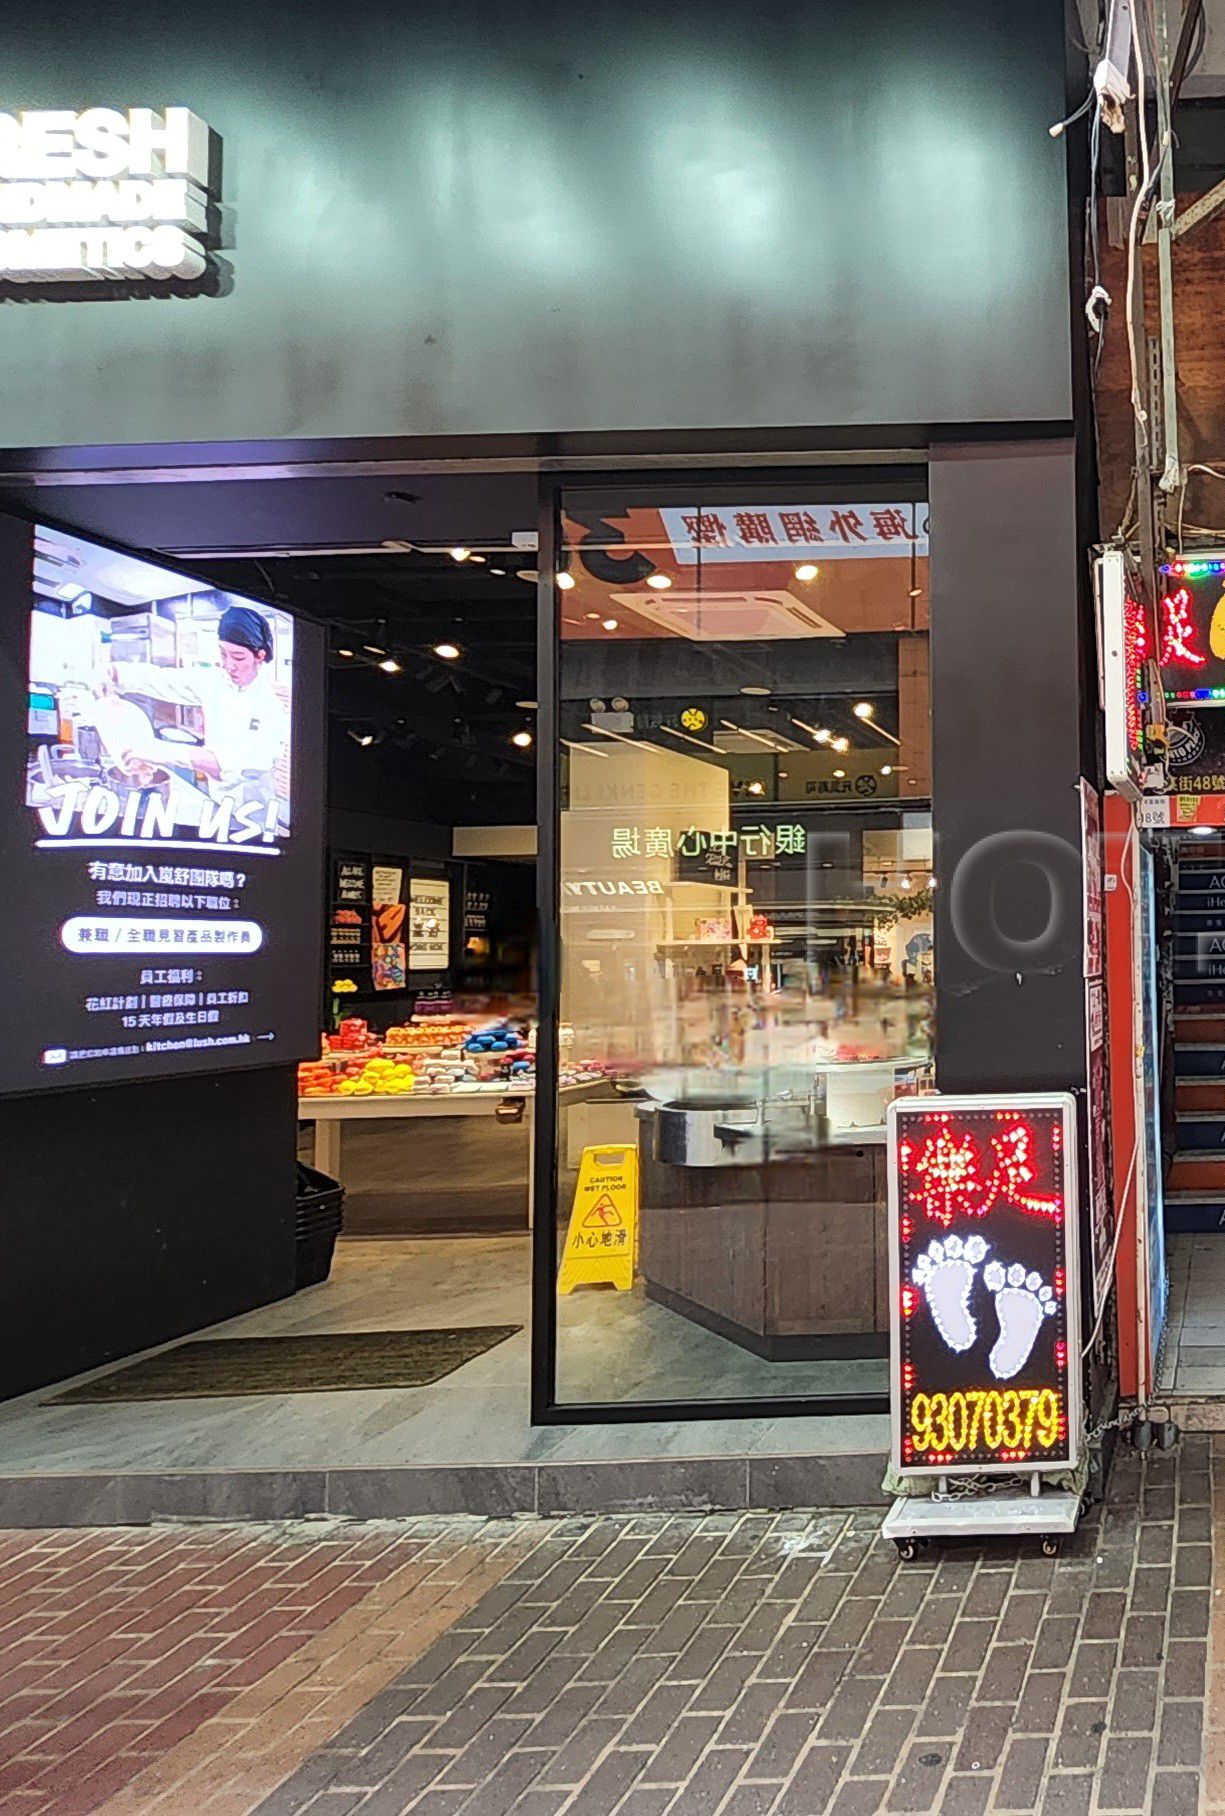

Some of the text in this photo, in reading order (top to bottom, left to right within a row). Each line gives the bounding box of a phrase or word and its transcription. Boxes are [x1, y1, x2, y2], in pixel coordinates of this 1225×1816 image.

[36, 782, 180, 838] JOIN
[571, 1230, 628, 1250] 小心地滑
[911, 1389, 1060, 1452] 93070379
